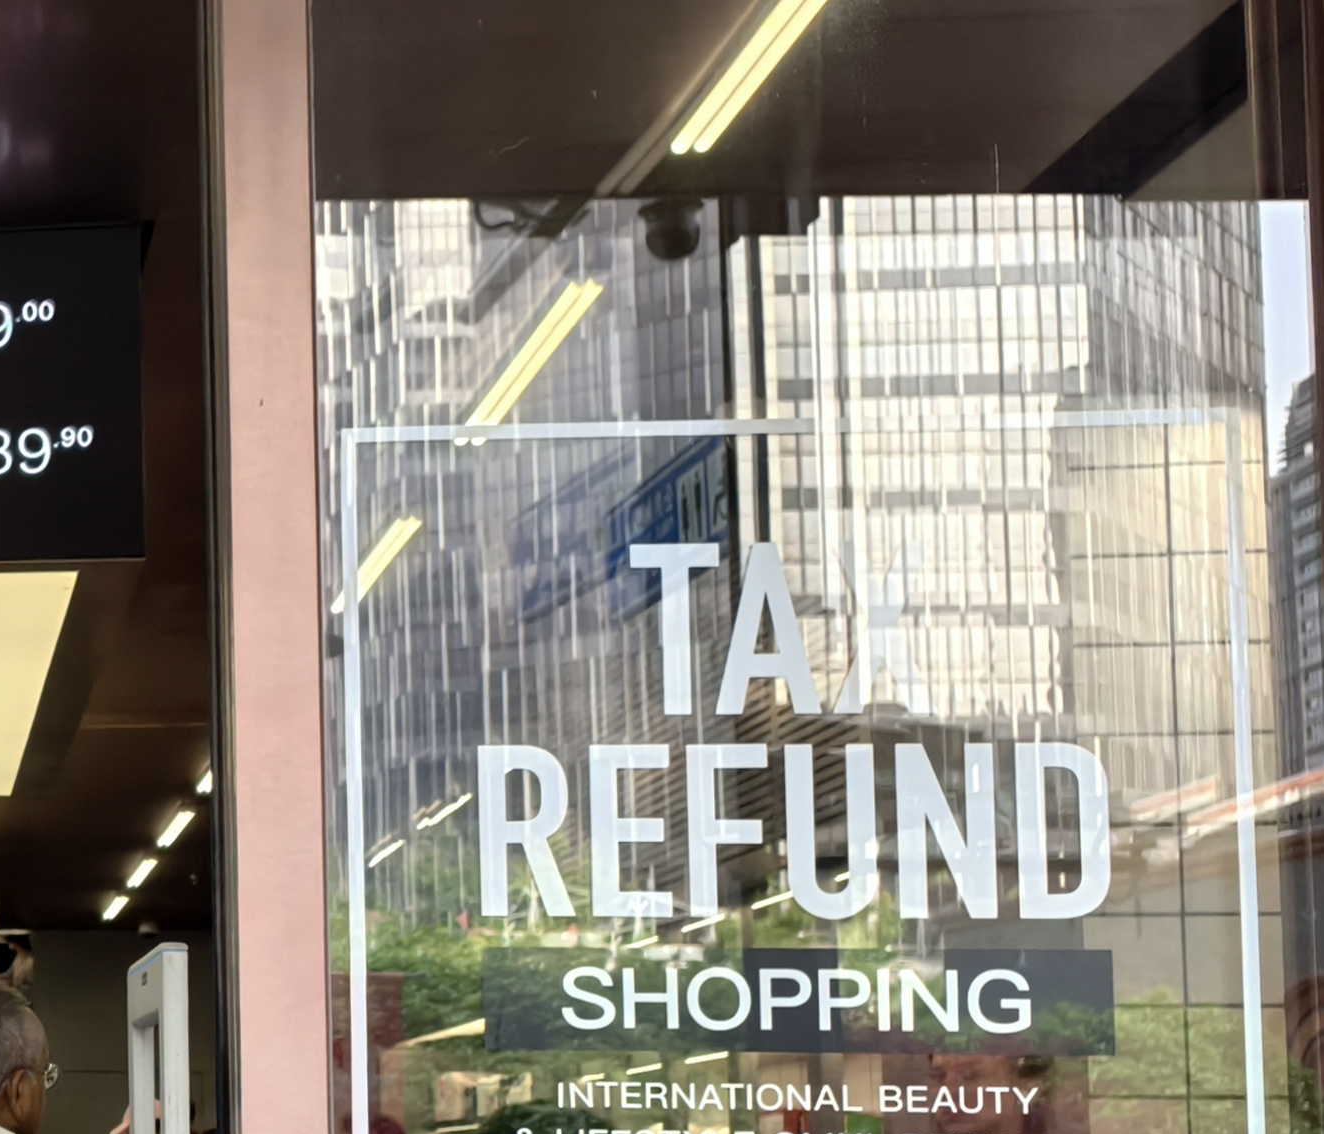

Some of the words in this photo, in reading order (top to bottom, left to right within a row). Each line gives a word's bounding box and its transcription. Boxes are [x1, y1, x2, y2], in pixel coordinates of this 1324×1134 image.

[478, 742, 1111, 920] REFUND
[561, 967, 1032, 1035] SHOPPING
[557, 1081, 864, 1112] INTERNATIONAL
[878, 1084, 1039, 1114] BEAUTY
